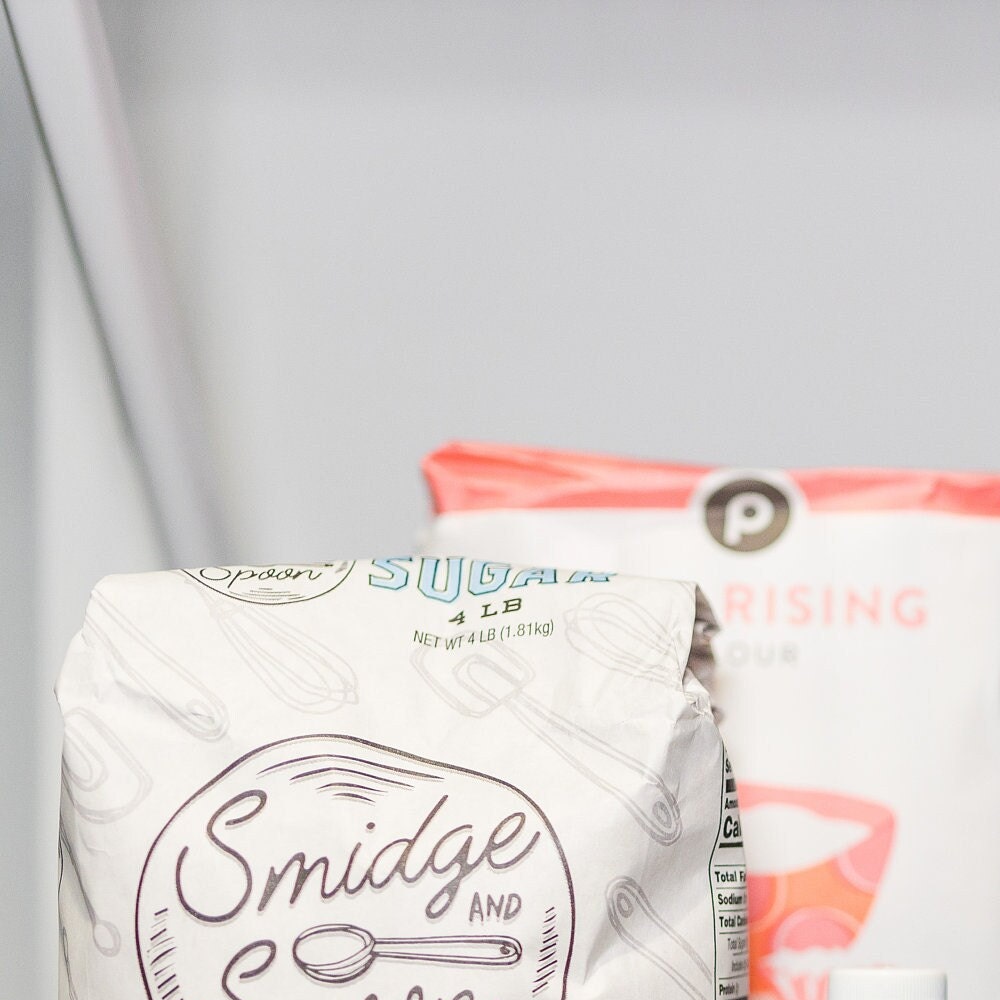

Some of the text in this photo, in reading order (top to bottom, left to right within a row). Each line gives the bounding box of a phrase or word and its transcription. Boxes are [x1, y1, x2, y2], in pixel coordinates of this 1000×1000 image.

[448, 598, 522, 625] 4 LB
[724, 583, 928, 628] RISING
[414, 620, 554, 652] NET WT 4 LB (1.81kg)
[175, 789, 540, 923] Smidge
[469, 892, 521, 922] AND
